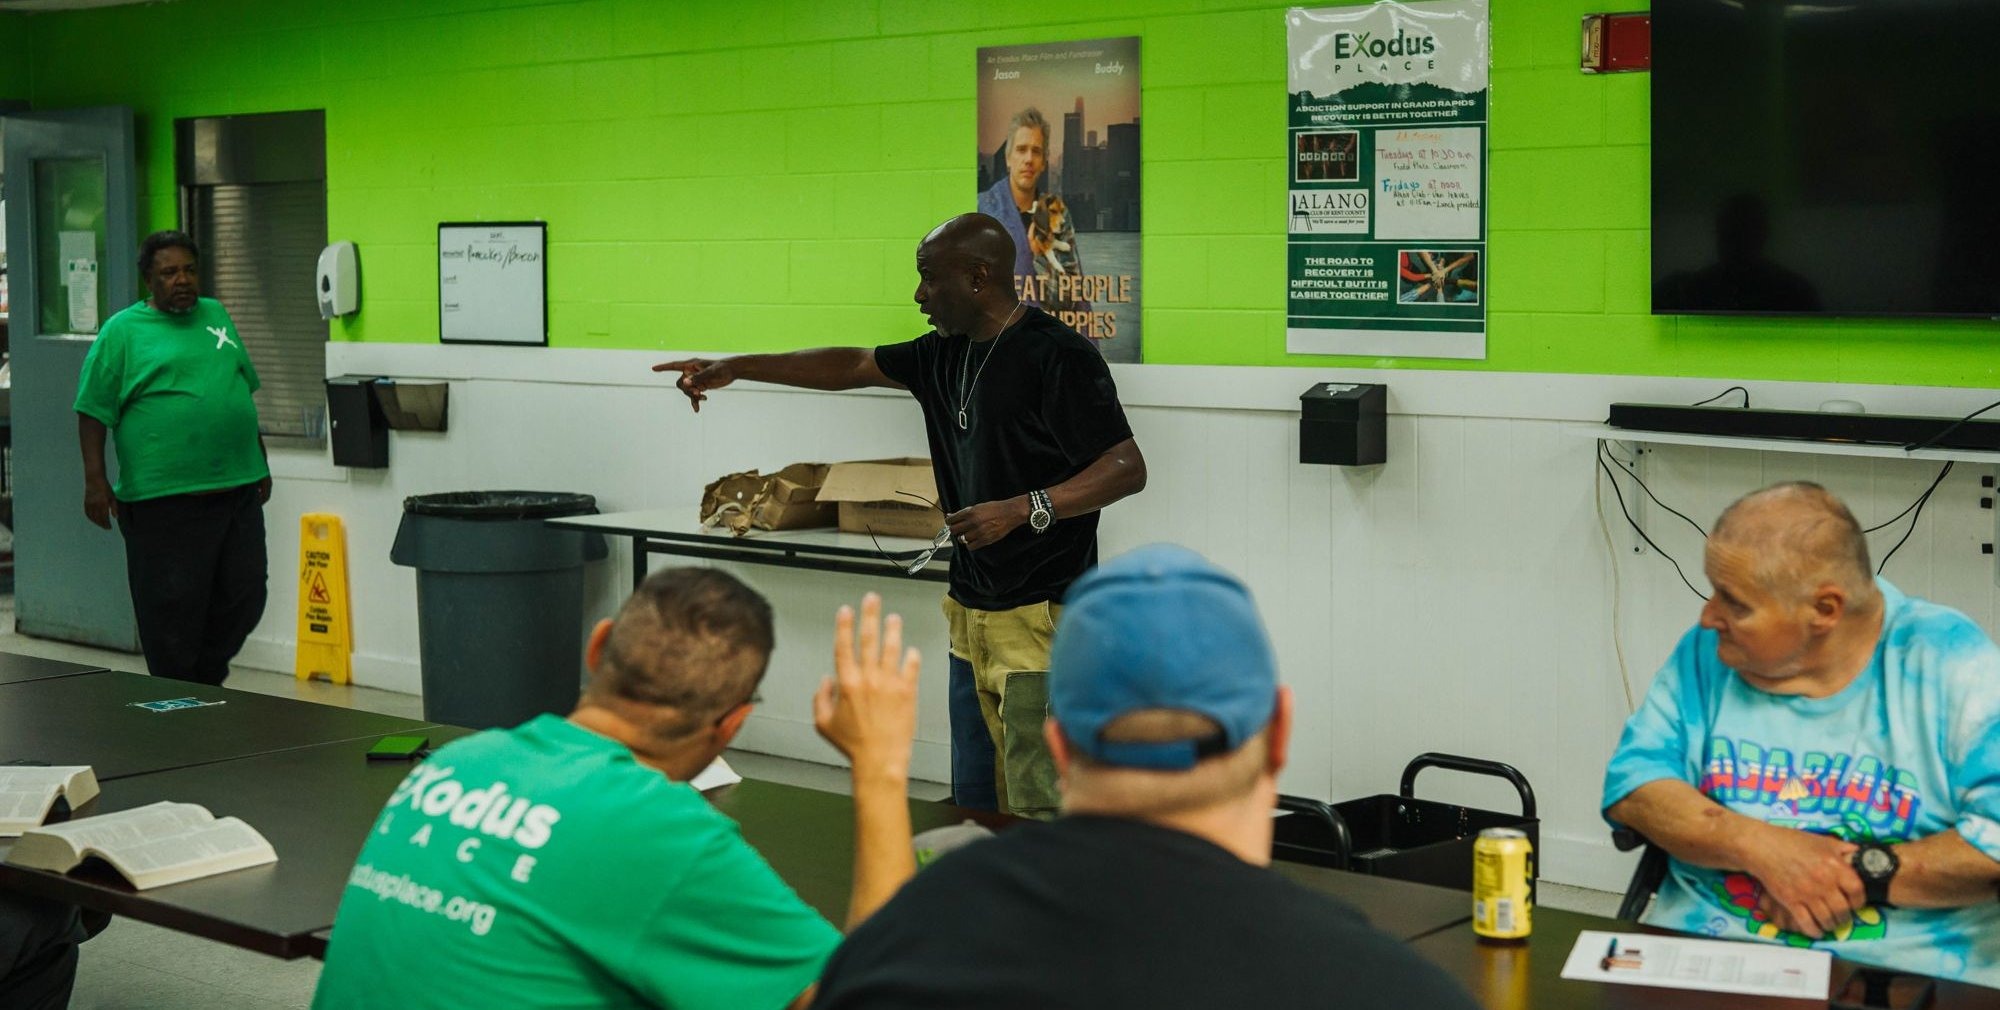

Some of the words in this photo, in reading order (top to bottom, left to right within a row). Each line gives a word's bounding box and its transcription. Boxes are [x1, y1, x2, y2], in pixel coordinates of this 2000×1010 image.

[993, 68, 1020, 80] Jason
[1094, 61, 1124, 76] Buddy
[1296, 104, 1346, 112] ADDICTION
[1347, 103, 1390, 111] SUPPORT
[1402, 101, 1437, 109] GRAND
[1311, 113, 1361, 121] RECOVERY
[1372, 112, 1408, 120] BETTER
[1409, 110, 1458, 119] TOGETHER
[1376, 148, 1413, 164] Tuesdays
[1382, 178, 1420, 192] Fridays
[1298, 193, 1367, 209] ALANO
[1304, 257, 1326, 265] THE
[1327, 257, 1359, 265] ROAD
[1360, 257, 1374, 265] TO
[1304, 268, 1363, 277] RECOVERY
[1364, 269, 1374, 277] IS
[1014, 275, 1049, 301] EAT
[1058, 274, 1132, 303] PEOPLE
[1291, 280, 1344, 288] DIFFICULT
[1345, 280, 1366, 288] BUT
[1378, 281, 1388, 289] IS
[1290, 291, 1328, 299] EASIER
[1051, 310, 1117, 339] PPIES
[305, 551, 330, 560] CAUTION
[379, 812, 538, 883] LACE
